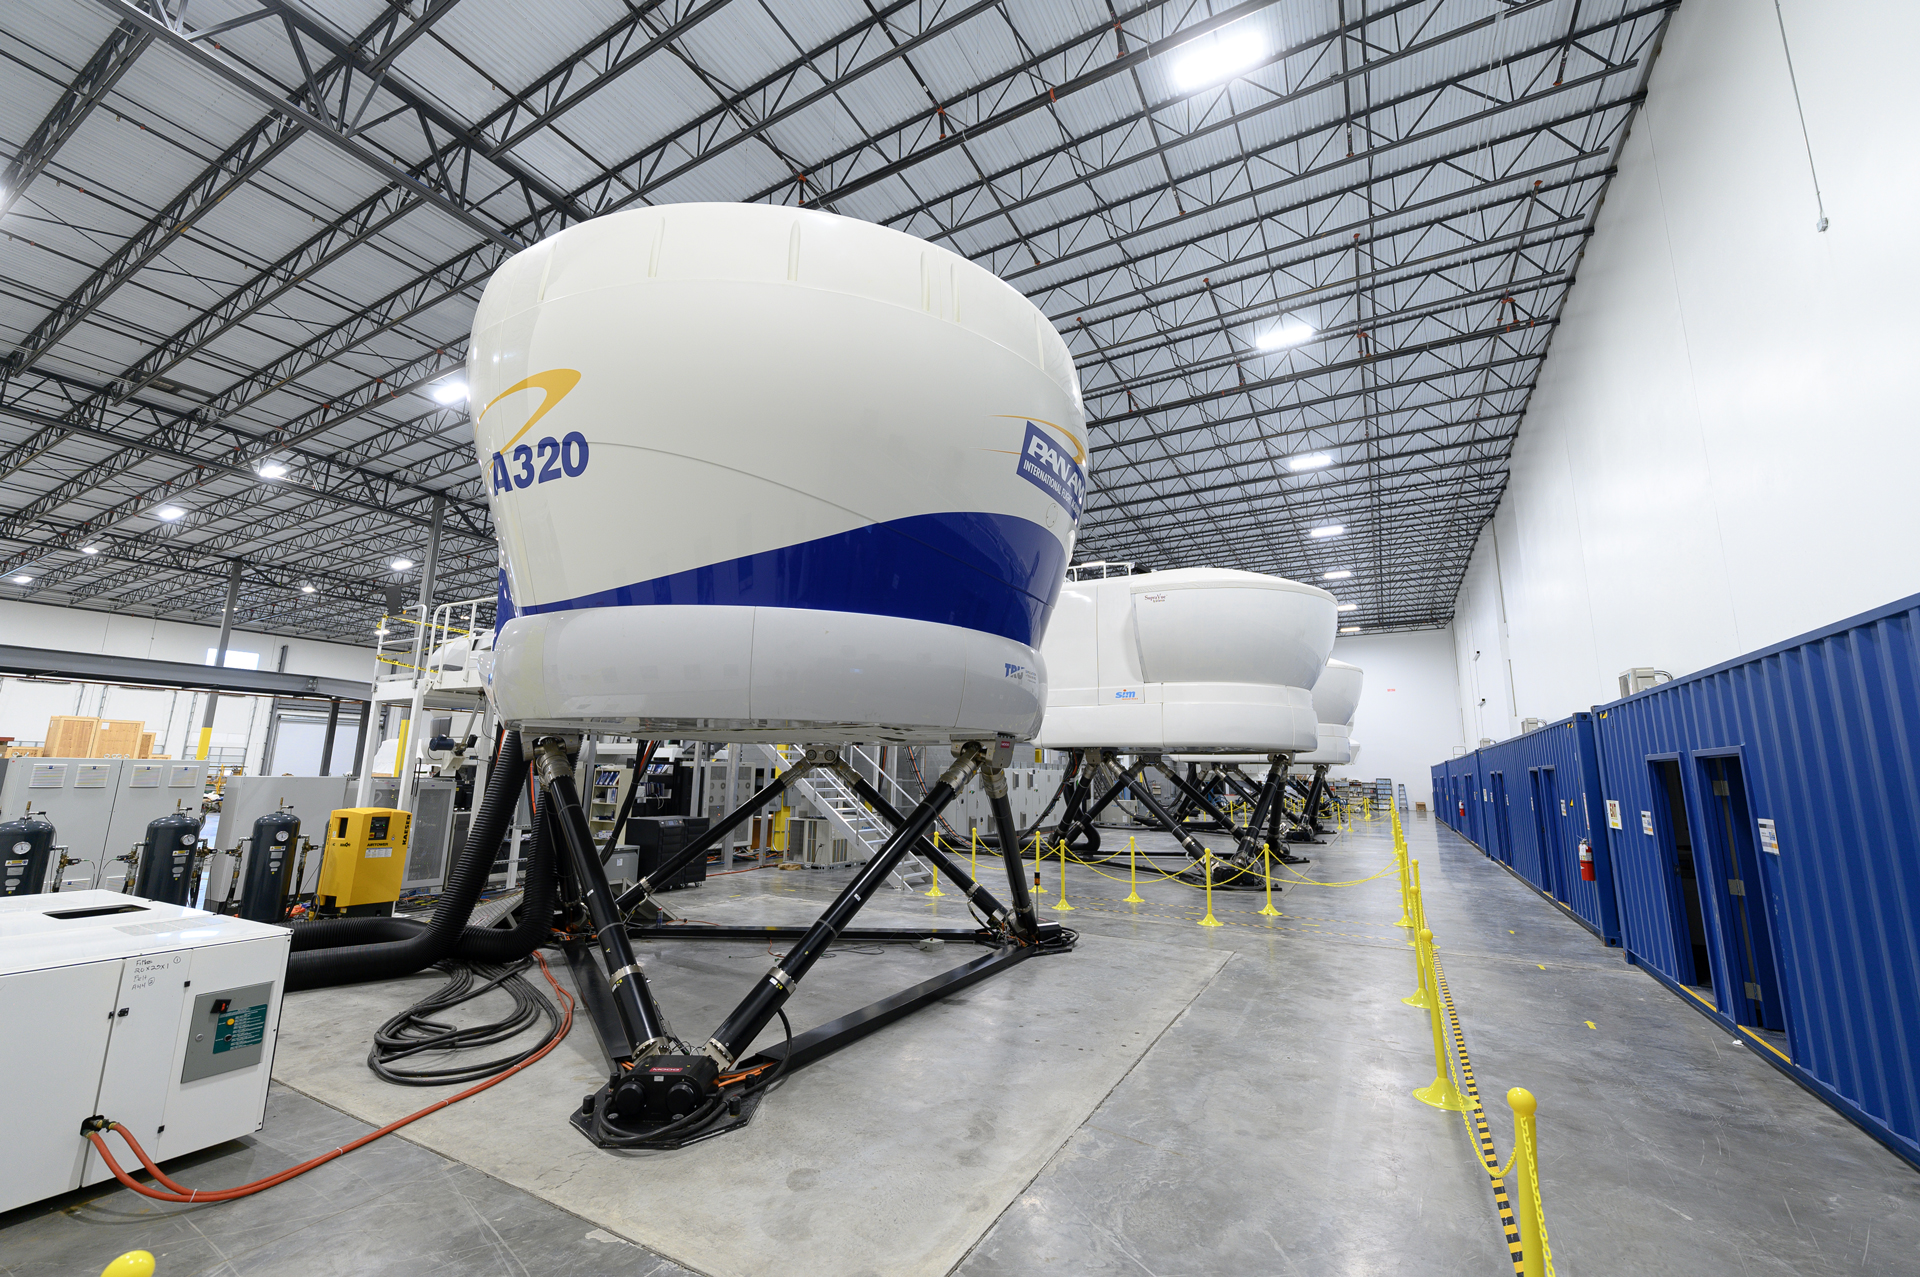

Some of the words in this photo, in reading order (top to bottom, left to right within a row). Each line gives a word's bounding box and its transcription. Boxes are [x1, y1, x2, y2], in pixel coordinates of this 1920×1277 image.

[493, 431, 589, 496] A320
[1027, 435, 1071, 481] PAN
[1023, 460, 1061, 495] INTERNATIONAL
[1115, 689, 1136, 698] sim
[402, 814, 411, 846] KAESER
